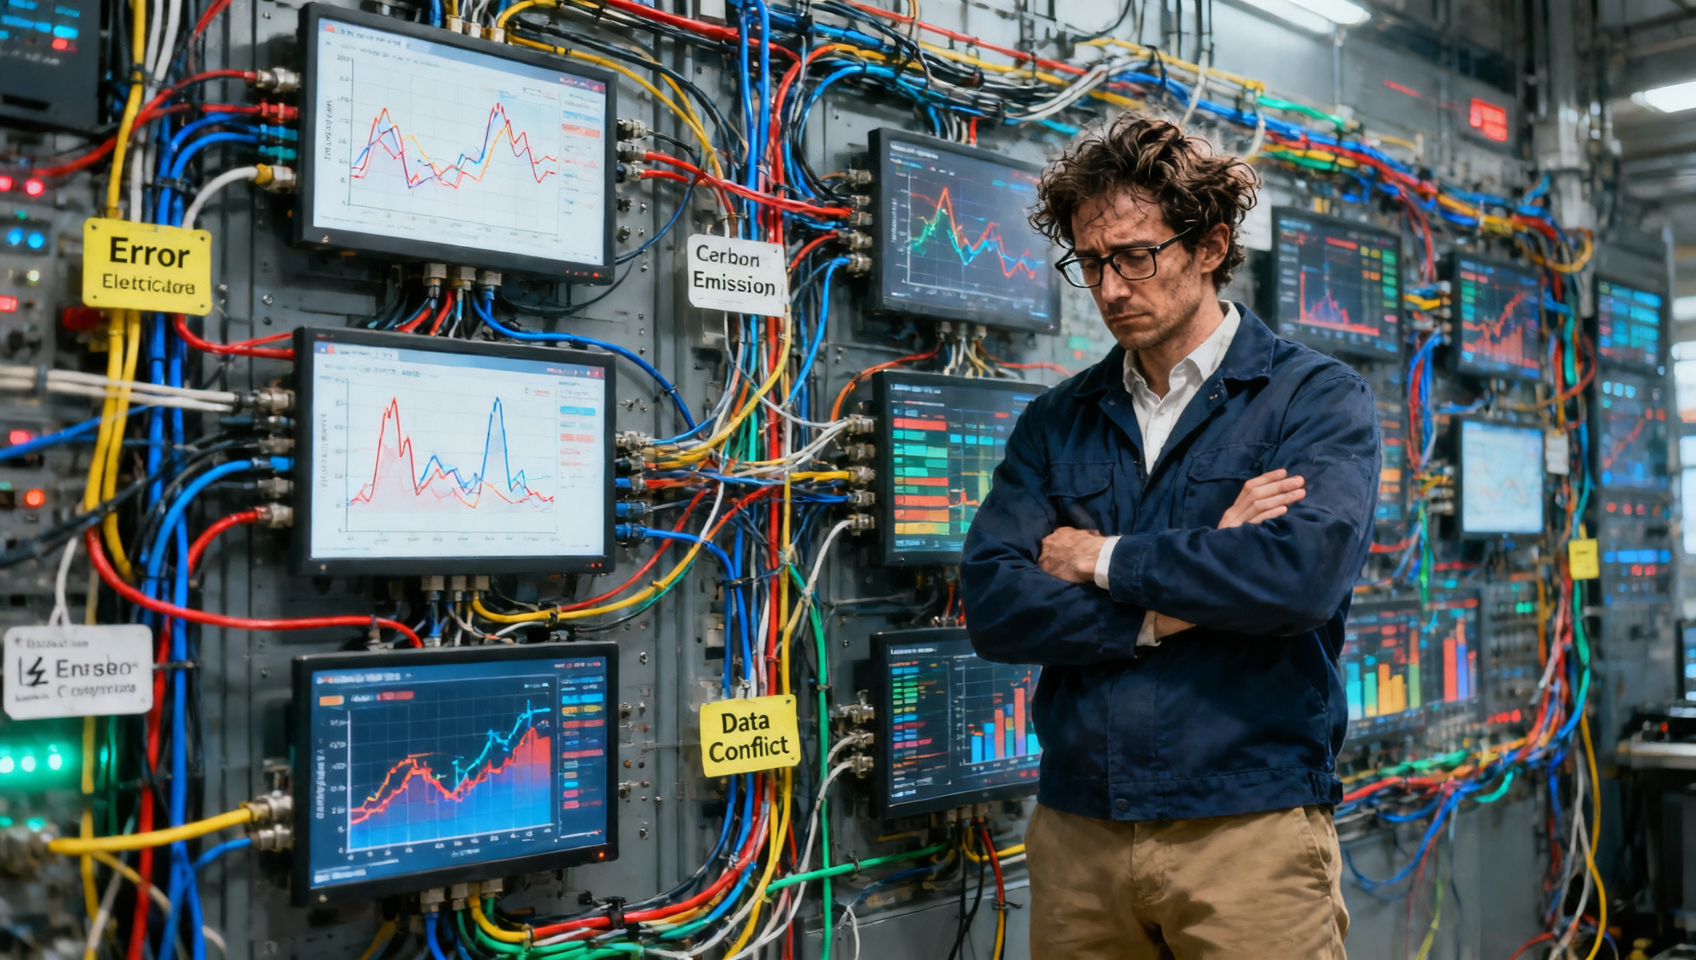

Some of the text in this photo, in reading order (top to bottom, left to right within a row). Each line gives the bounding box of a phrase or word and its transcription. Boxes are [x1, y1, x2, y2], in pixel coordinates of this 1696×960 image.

[110, 236, 190, 268] Error
[694, 270, 776, 296] Emission
[721, 712, 770, 734] Data
[709, 736, 790, 763] Conflict
